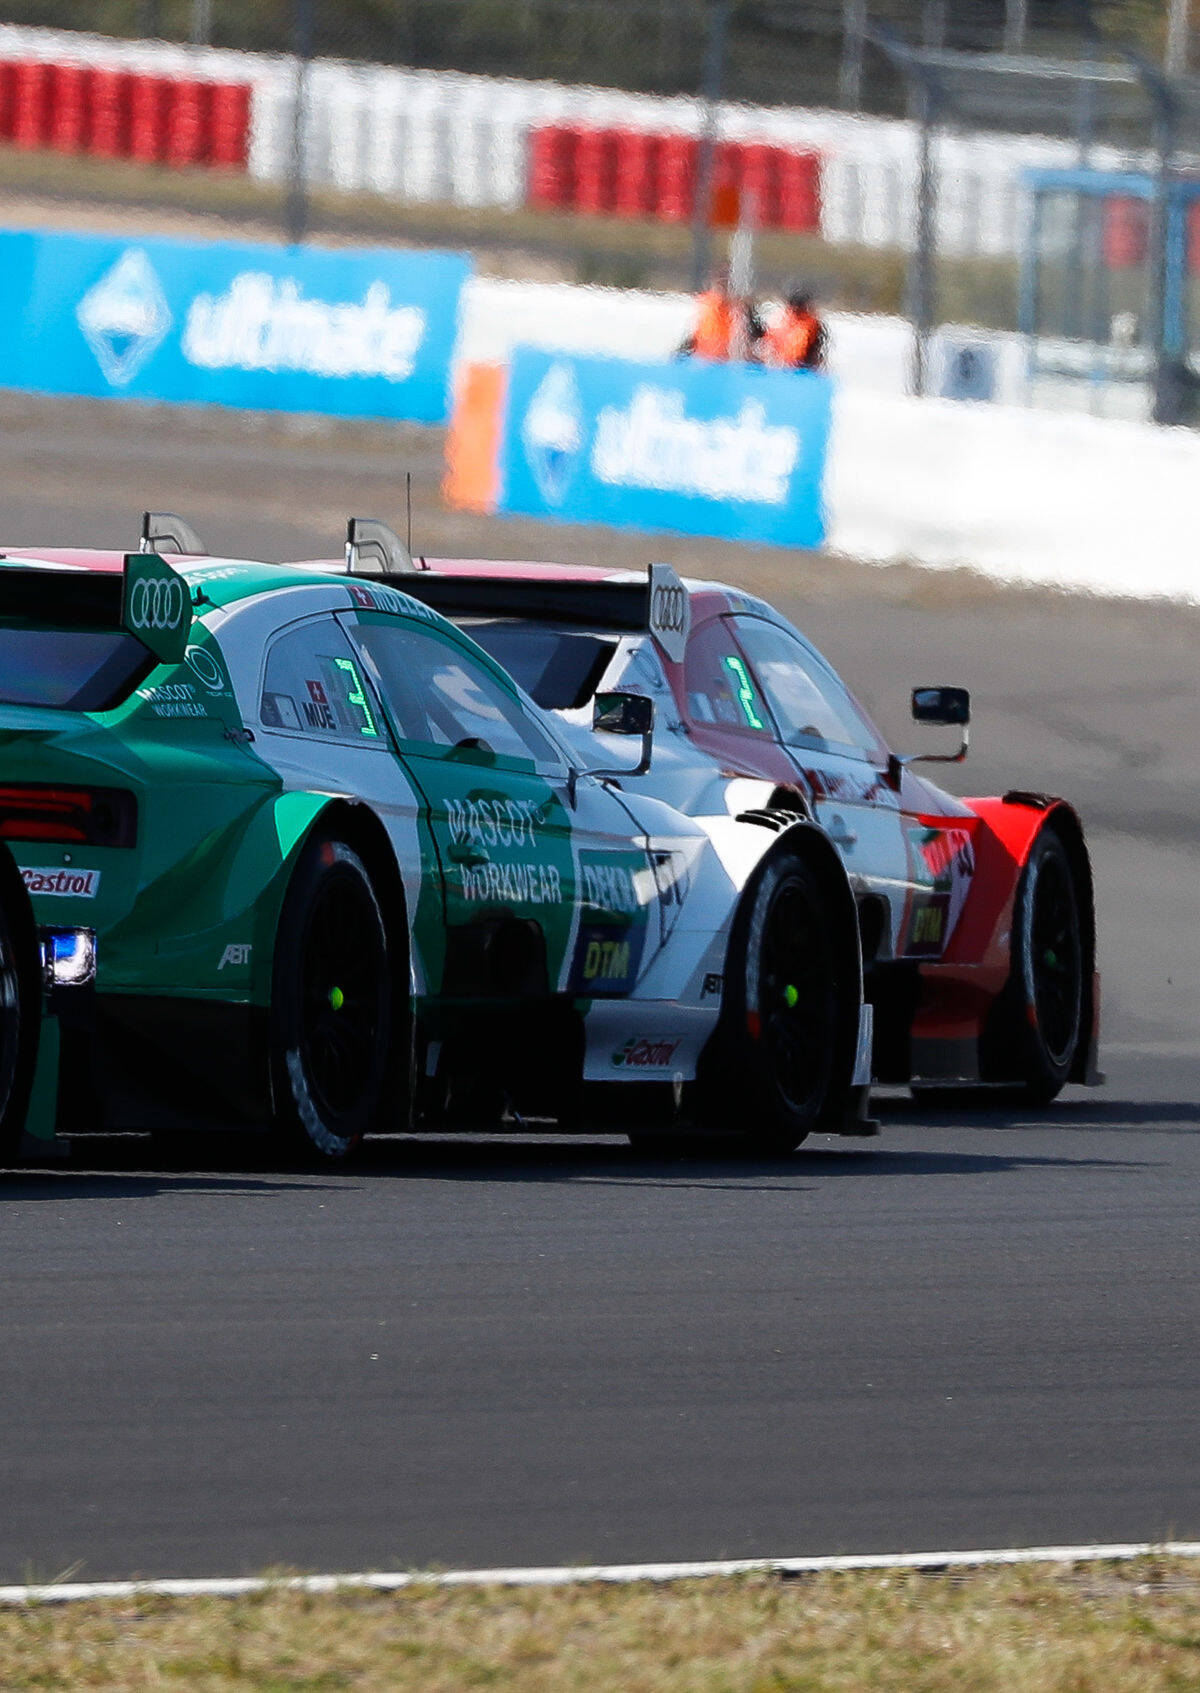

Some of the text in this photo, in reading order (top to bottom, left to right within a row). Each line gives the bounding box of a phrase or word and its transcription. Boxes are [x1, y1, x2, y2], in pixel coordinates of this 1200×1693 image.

[301, 702, 336, 730] MUE
[334, 657, 378, 738] 3
[443, 799, 538, 848] MASCOT
[21, 869, 94, 895] Castrol
[459, 863, 562, 904] WORKWEAR
[217, 943, 252, 970] ABT
[583, 941, 631, 979] DTM
